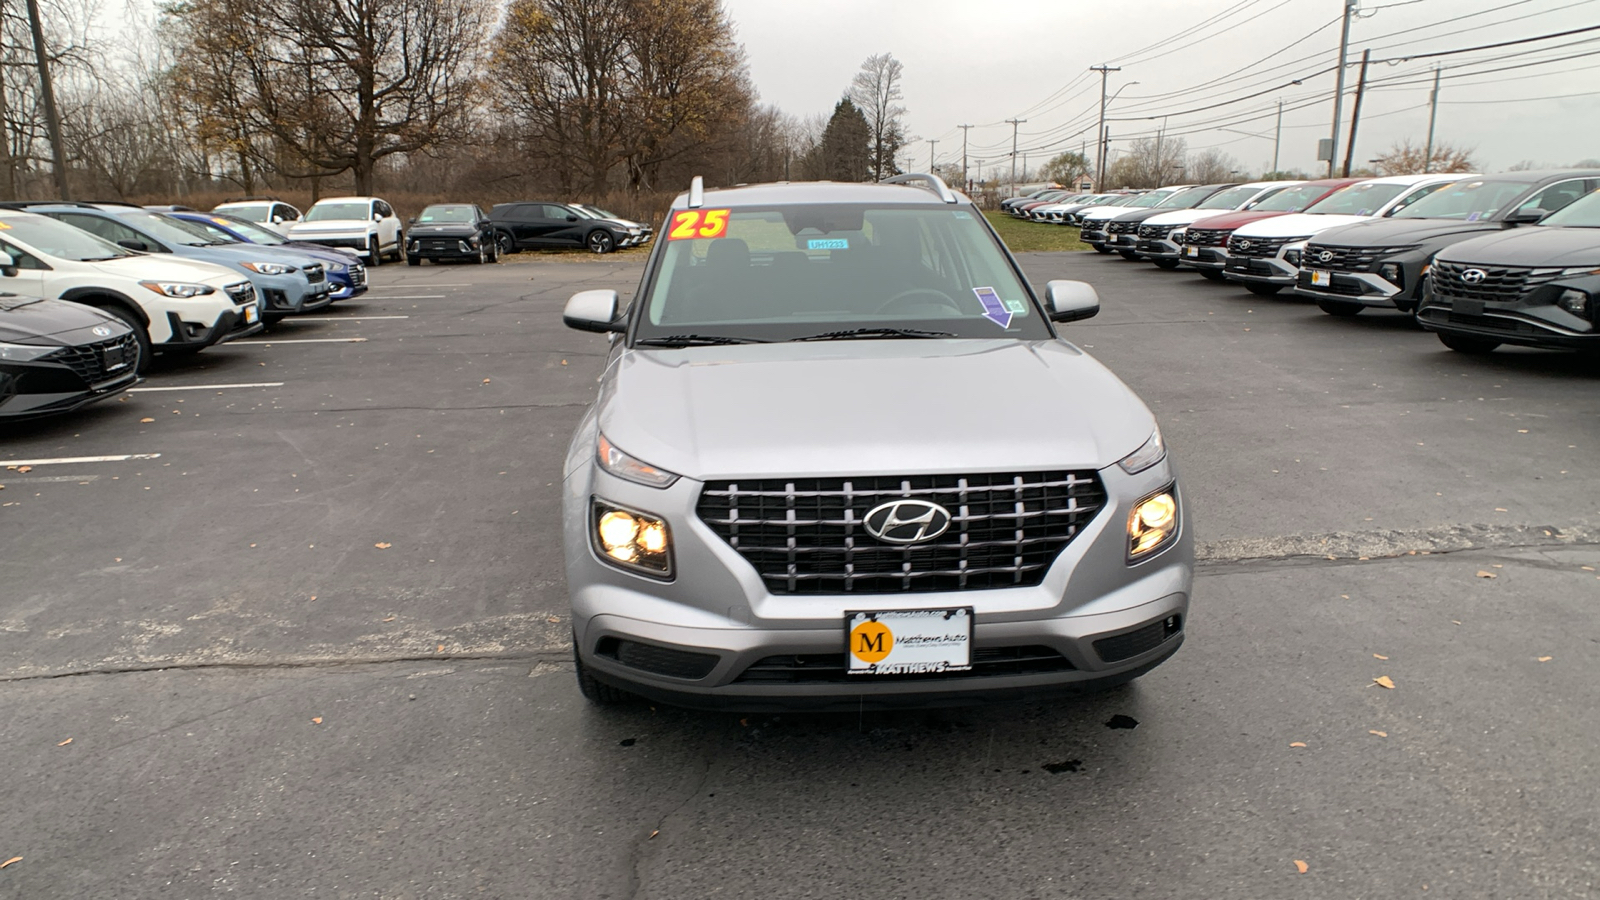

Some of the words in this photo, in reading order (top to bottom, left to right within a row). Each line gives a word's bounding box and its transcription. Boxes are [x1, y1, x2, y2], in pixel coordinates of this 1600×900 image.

[670, 209, 729, 238] 25
[857, 631, 887, 653] M
[943, 632, 968, 643] Auto
[875, 661, 946, 675] MATTHEWS
